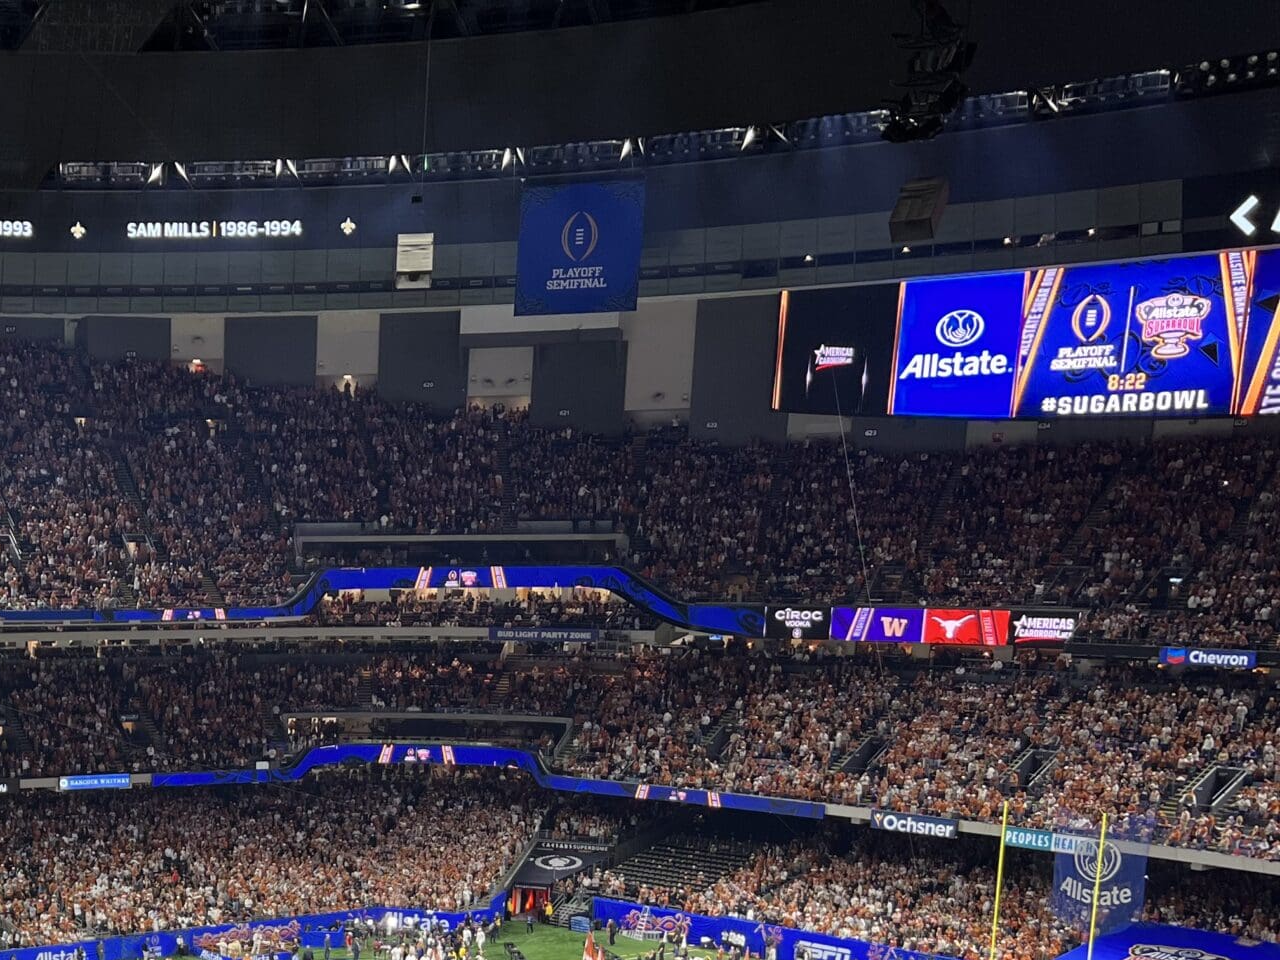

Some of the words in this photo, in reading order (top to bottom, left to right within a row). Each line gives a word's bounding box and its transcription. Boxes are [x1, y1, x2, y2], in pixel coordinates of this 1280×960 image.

[126, 221, 161, 238] SAM
[163, 221, 210, 238] MILLS
[219, 219, 303, 237] 1986-1994
[552, 266, 603, 279] PLAYOFF
[546, 277, 607, 290] SEMIFINAL
[1148, 304, 1199, 320] Allstate
[1058, 345, 1116, 358] PLAYOFF
[1050, 355, 1118, 371] SEMIFINAL
[1107, 372, 1147, 391] 8:22
[1041, 390, 1209, 415] #SUGARBOWL
[785, 620, 811, 628] VODKA
[880, 616, 909, 637] W
[1018, 614, 1074, 629] AMERICAS
[497, 630, 514, 638] BUD
[515, 630, 539, 638] LIGHT
[541, 631, 568, 639] PARTY
[569, 632, 592, 640] ZONE
[1188, 649, 1249, 666] Chevron
[882, 813, 954, 838] Ochsner
[541, 842, 572, 850] CAESARS
[573, 844, 608, 852] SUPERDOME
[1005, 830, 1049, 848] PEOPLES
